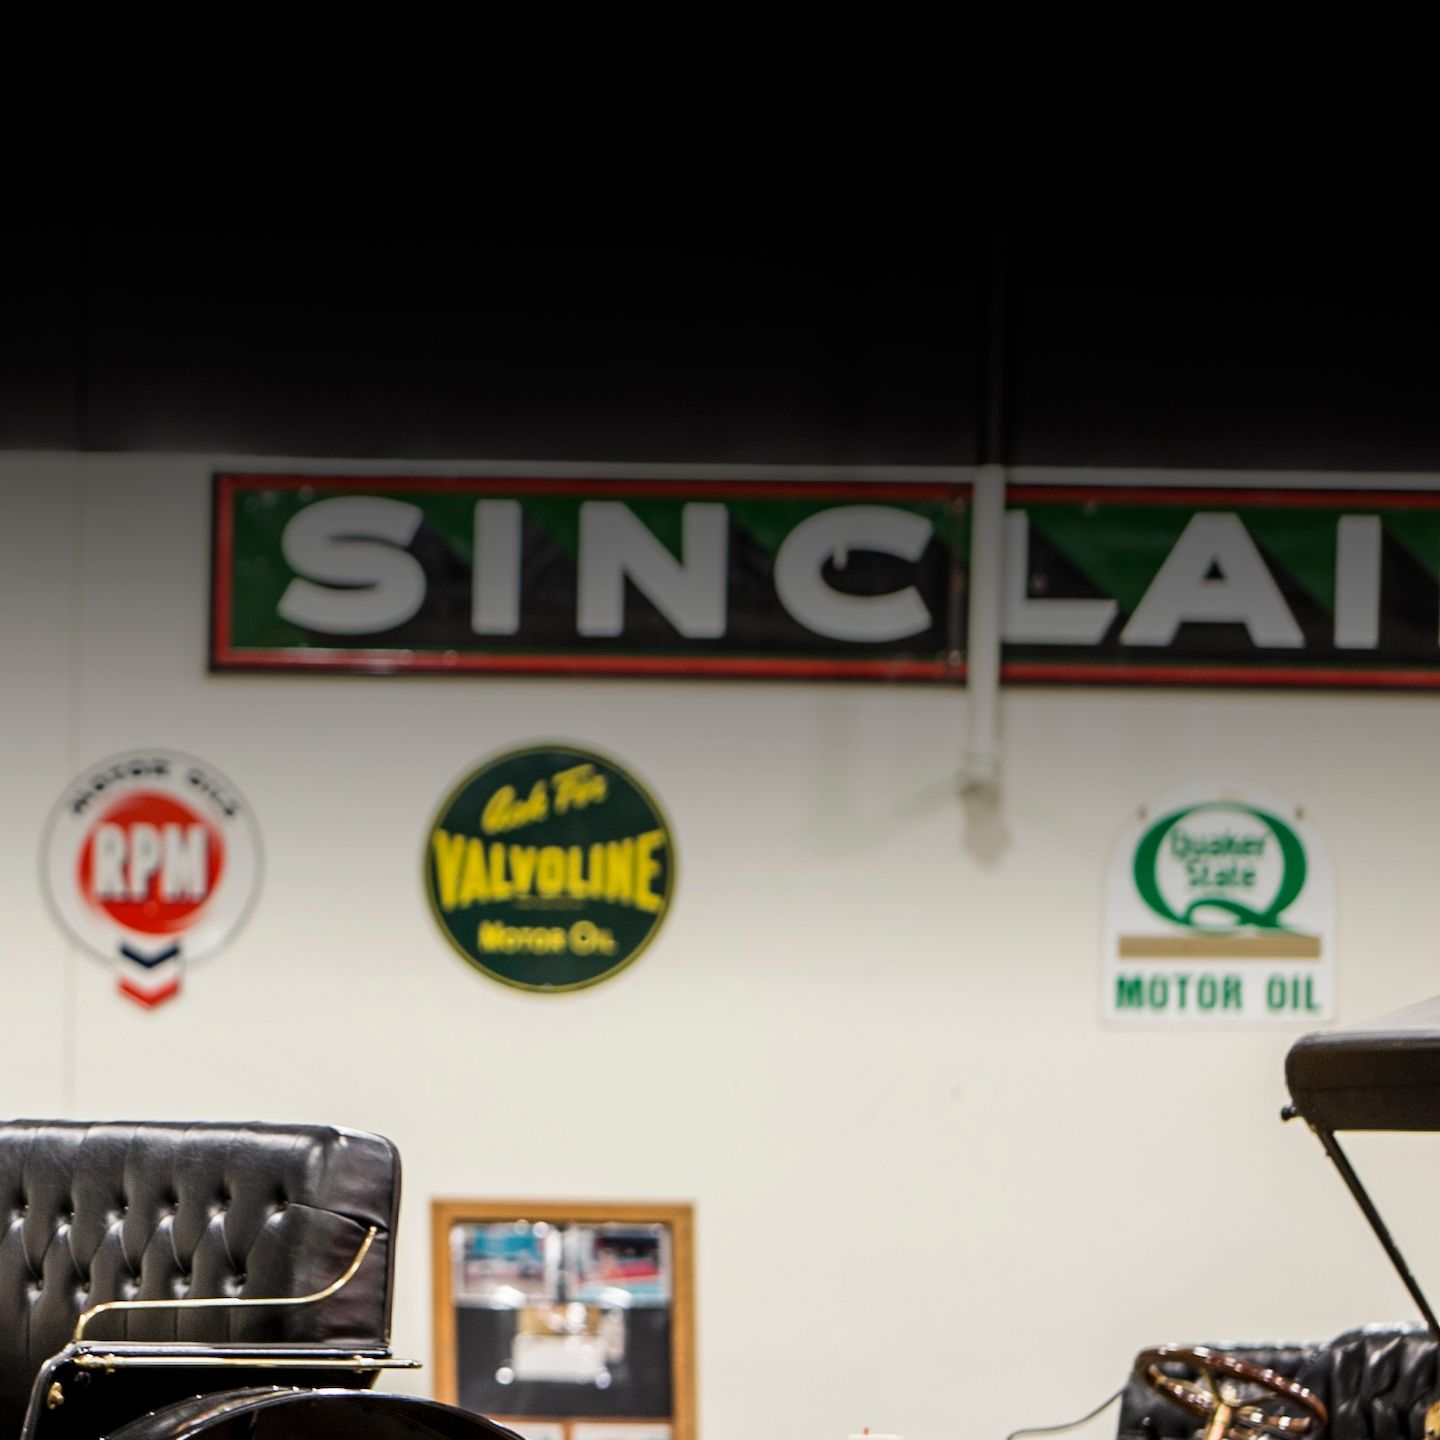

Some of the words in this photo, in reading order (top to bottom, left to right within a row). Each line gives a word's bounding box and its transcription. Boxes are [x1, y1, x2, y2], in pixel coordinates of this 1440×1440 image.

[277, 495, 1440, 651] SINCLAI
[70, 758, 172, 817] MOTOR
[93, 823, 208, 904] RPM
[432, 829, 666, 914] VALVOLINE
[1170, 828, 1268, 862] Quaker
[1184, 860, 1256, 886] State
[1115, 974, 1242, 1010] MOTOR
[1266, 975, 1318, 1010] OIL
